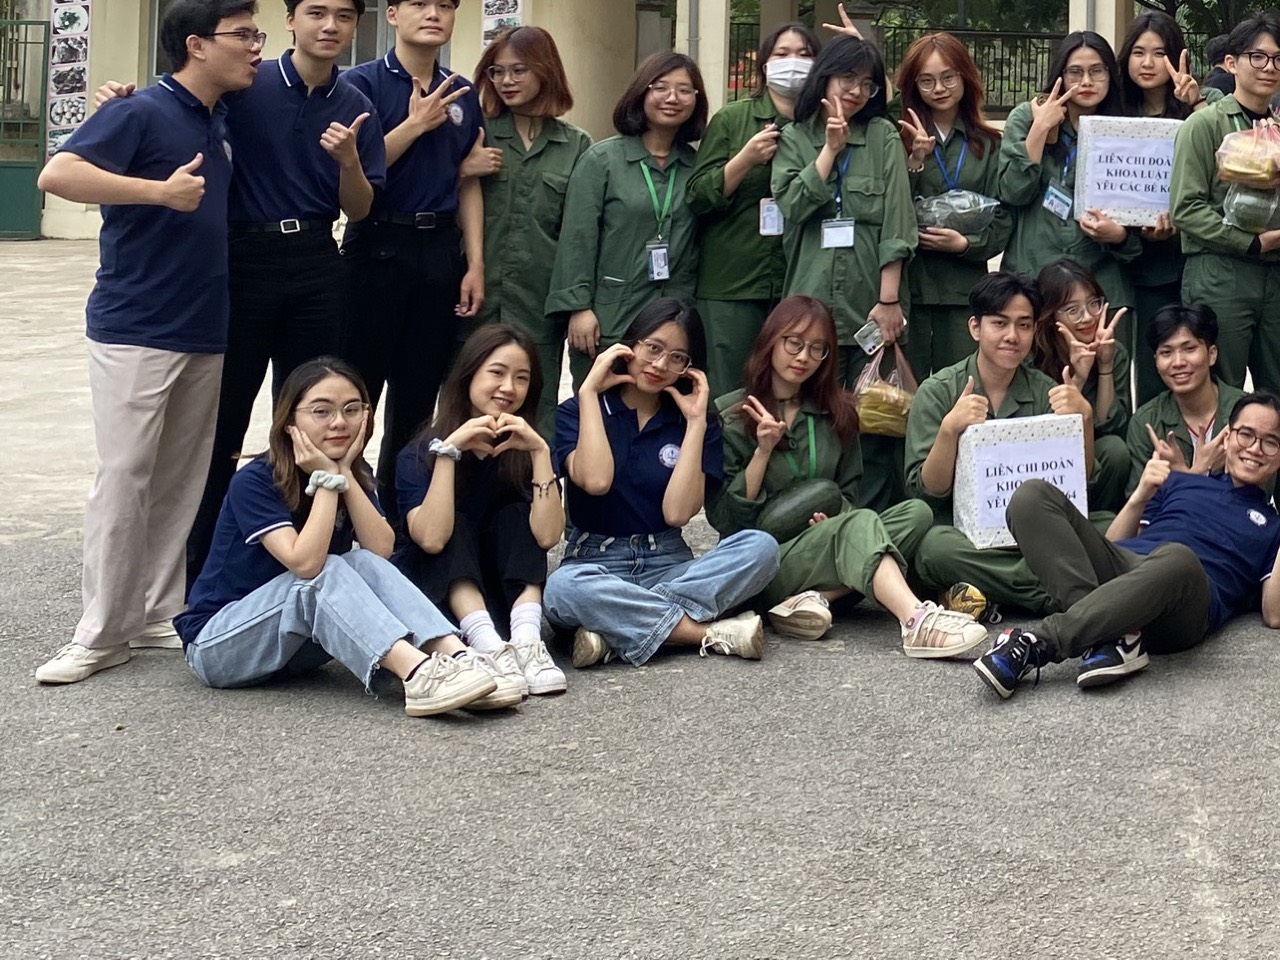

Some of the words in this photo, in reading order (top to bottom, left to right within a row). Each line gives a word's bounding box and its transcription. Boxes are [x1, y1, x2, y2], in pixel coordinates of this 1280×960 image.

[1098, 152, 1124, 163] LIÊN
[1126, 156, 1146, 165] CHI
[1148, 155, 1171, 166] ĐOÀ
[1106, 168, 1137, 178] KHOA
[1141, 169, 1169, 181] LUẬT
[1096, 180, 1117, 190] YÊU
[1119, 181, 1141, 192] CÁC
[1144, 182, 1158, 192] BÉ
[986, 463, 1013, 477] LIÊN
[1017, 462, 1038, 473] CHI
[1041, 457, 1074, 471] ĐOÀN
[996, 480, 1023, 492] KHO
